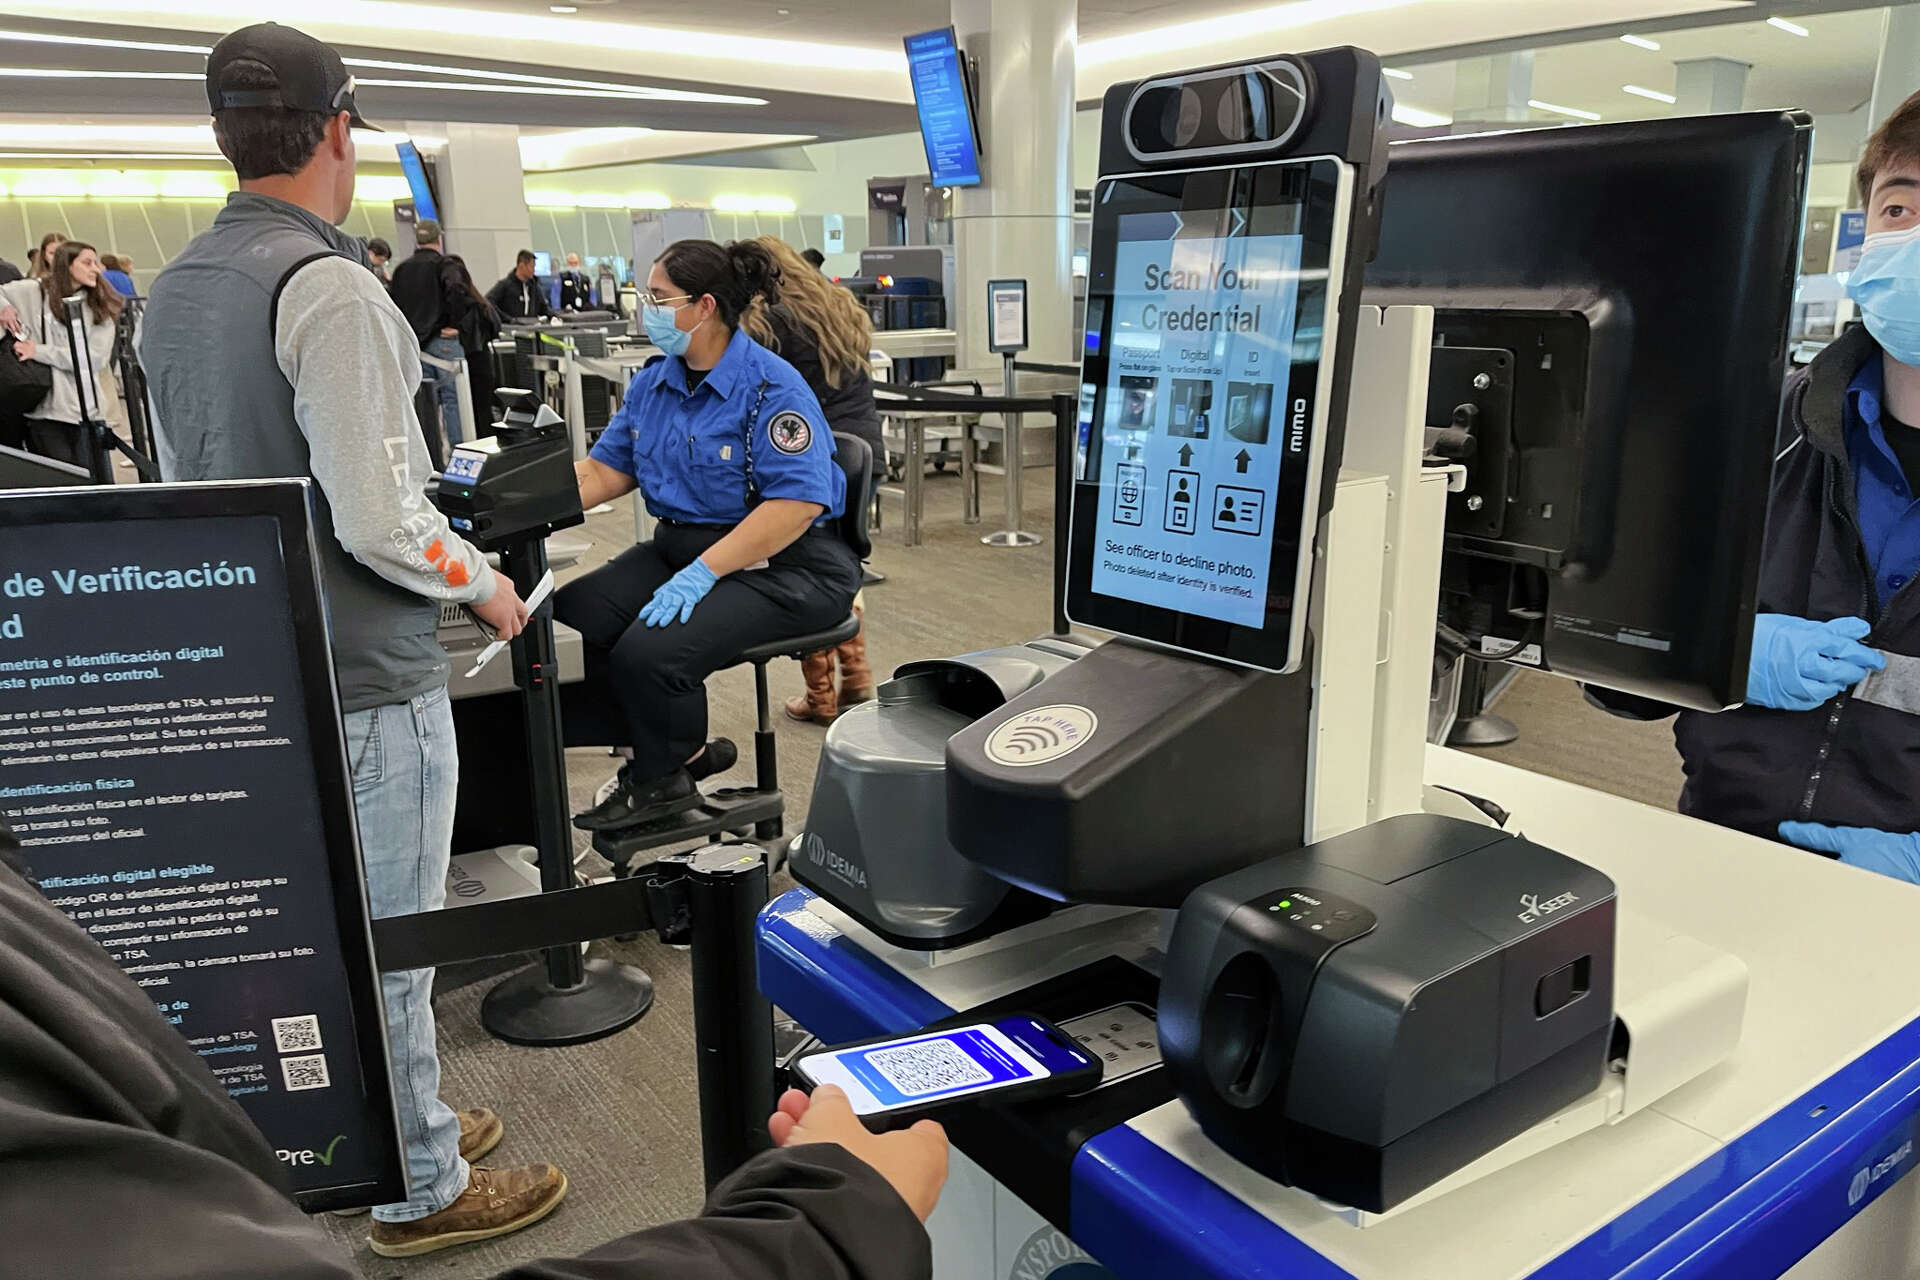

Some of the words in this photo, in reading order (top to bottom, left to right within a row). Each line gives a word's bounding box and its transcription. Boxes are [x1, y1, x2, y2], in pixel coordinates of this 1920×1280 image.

[1144, 263, 1199, 291] Scan
[1210, 262, 1261, 290] Your
[1142, 304, 1261, 332] Credential
[1180, 349, 1210, 362] Digital
[1248, 351, 1259, 363] ID
[1290, 398, 1307, 452] mimo
[1105, 539, 1124, 554] See
[1126, 544, 1160, 561] officer
[1162, 550, 1173, 564] to
[1175, 552, 1216, 572] decline
[1217, 562, 1256, 580] photo.
[3, 572, 45, 598] de
[51, 561, 257, 595] Verificación
[1103, 560, 1126, 573] Photo
[1127, 566, 1156, 580] deleted
[1157, 571, 1176, 583] after
[1177, 575, 1209, 592] identity
[1209, 581, 1217, 592] is
[1218, 584, 1253, 599] verified.
[52, 658, 63, 669] e
[66, 650, 172, 669] identificación
[175, 645, 225, 663] digital
[30, 674, 76, 691] punto
[79, 671, 99, 685] de
[103, 667, 164, 683] control.
[14, 712, 28, 720] en
[29, 710, 41, 719] el
[62, 708, 77, 717] de
[166, 700, 181, 709] de
[209, 698, 224, 706] se
[51, 725, 65, 733] su
[237, 709, 268, 720] digital
[1055, 719, 1078, 741] HERE
[35, 740, 51, 748] de
[161, 729, 178, 739] Su
[54, 753, 70, 761] de
[204, 741, 219, 750] de
[219, 741, 233, 749] su
[7, 809, 22, 817] su
[127, 799, 143, 807] en
[144, 796, 156, 806] el
[155, 794, 188, 805] lector
[189, 792, 205, 802] de
[70, 819, 86, 827] su
[92, 831, 111, 841] del
[112, 868, 157, 884] digital
[159, 864, 215, 879] elegible
[826, 849, 868, 889] IDEMIA
[88, 892, 109, 904] QR
[109, 892, 125, 901] de
[197, 881, 230, 894] digital
[231, 881, 240, 889] o
[273, 877, 288, 885] su
[76, 911, 93, 920] en
[93, 908, 105, 918] el
[105, 906, 136, 917] lector
[137, 904, 153, 914] de
[88, 922, 146, 933] dispositivo
[177, 916, 189, 925] le
[225, 911, 247, 921] que
[264, 908, 279, 916] su
[102, 935, 153, 947] compartir
[154, 934, 169, 942] su
[233, 924, 249, 934] de
[184, 959, 196, 968] la
[277, 950, 292, 958] su
[171, 1000, 190, 1010] de
[227, 1076, 241, 1084] de
